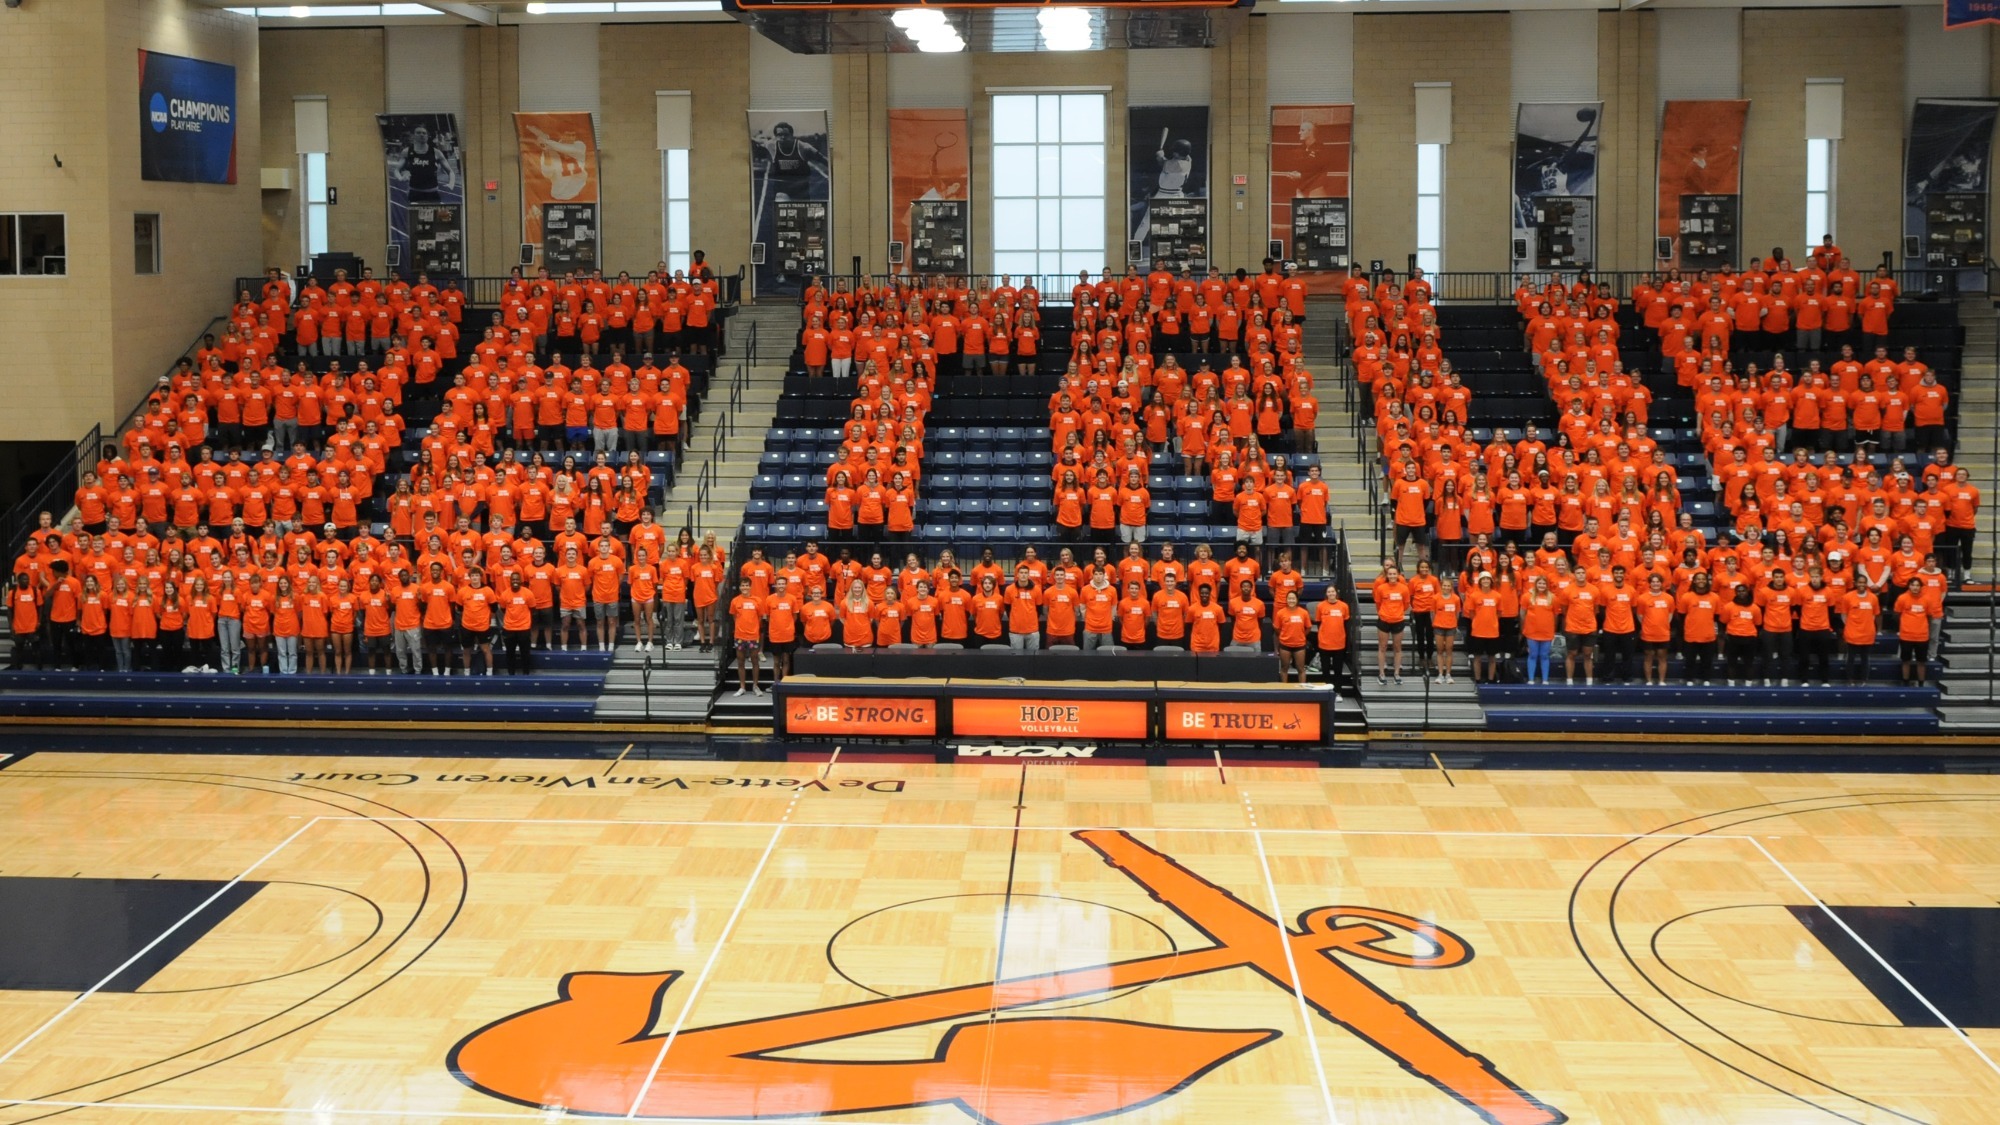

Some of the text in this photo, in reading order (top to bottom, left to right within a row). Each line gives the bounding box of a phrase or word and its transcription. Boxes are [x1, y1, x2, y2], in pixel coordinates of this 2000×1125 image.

[170, 98, 230, 123] CHAMPIONS
[151, 111, 167, 123] NCAA
[170, 120, 186, 131] PLAY
[806, 264, 812, 272] 2
[1374, 262, 1381, 270] 3
[1951, 258, 1958, 267] 3
[1936, 275, 1943, 283] 3
[816, 705, 928, 723] BE STRONG.
[1020, 705, 1079, 722] HOPE
[1182, 711, 1279, 730] BE TRUE.
[1020, 725, 1079, 733] VOLLEYBALL
[957, 745, 1098, 758] NCAA
[288, 771, 420, 786] Court
